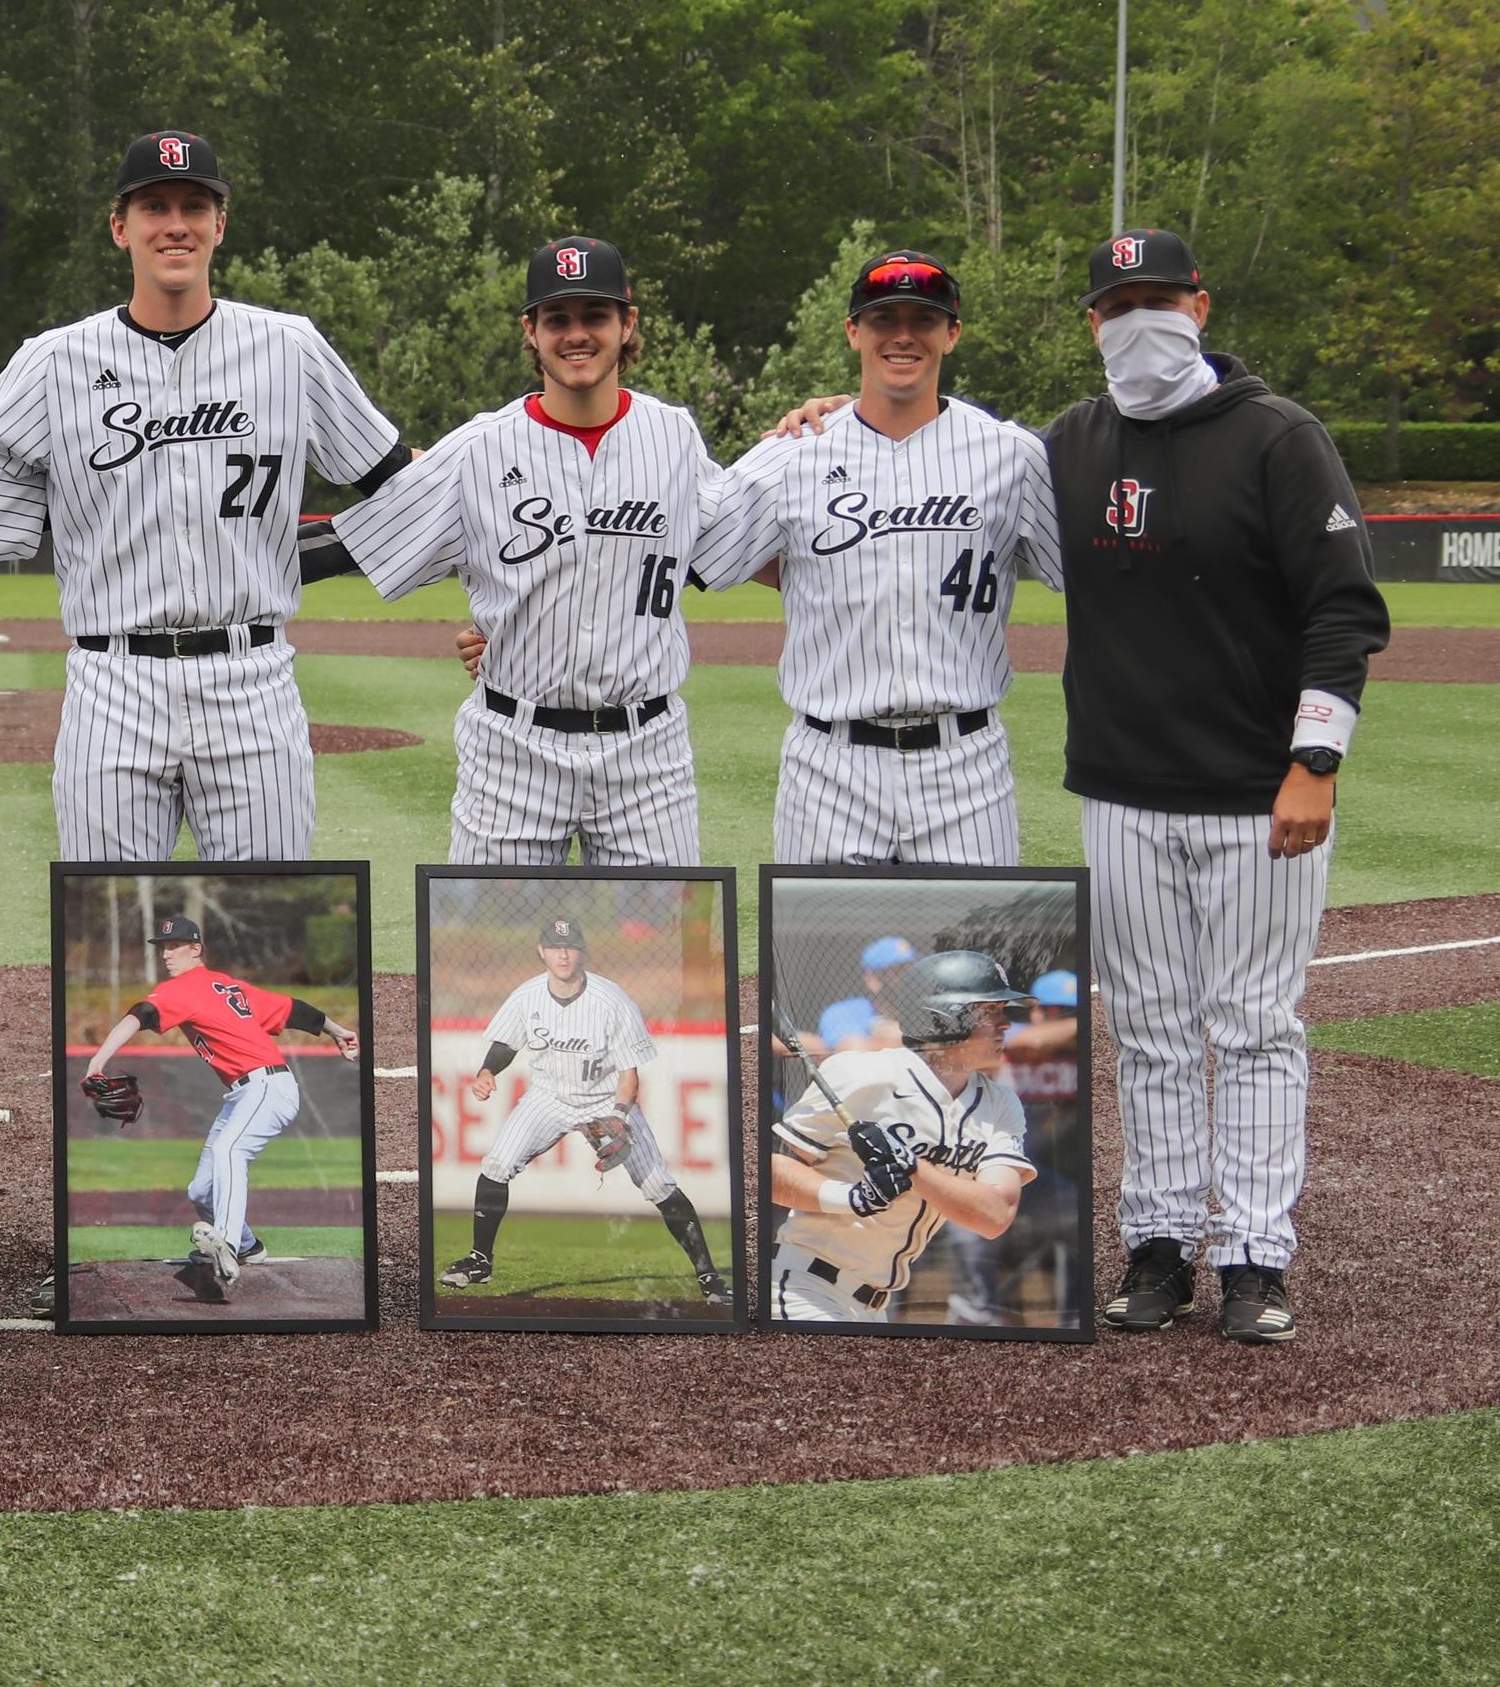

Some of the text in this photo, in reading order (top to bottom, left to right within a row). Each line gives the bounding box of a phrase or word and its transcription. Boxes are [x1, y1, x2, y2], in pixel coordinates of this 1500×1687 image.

[88, 400, 256, 472] Seattle
[219, 453, 283, 518] 27
[499, 497, 669, 565] Seattle
[811, 492, 984, 555] Seattle
[1442, 532, 1500, 568] HOME
[635, 554, 678, 618] 16
[940, 549, 998, 613] 46
[527, 1027, 594, 1055] Seattle
[581, 1059, 603, 1082] 16
